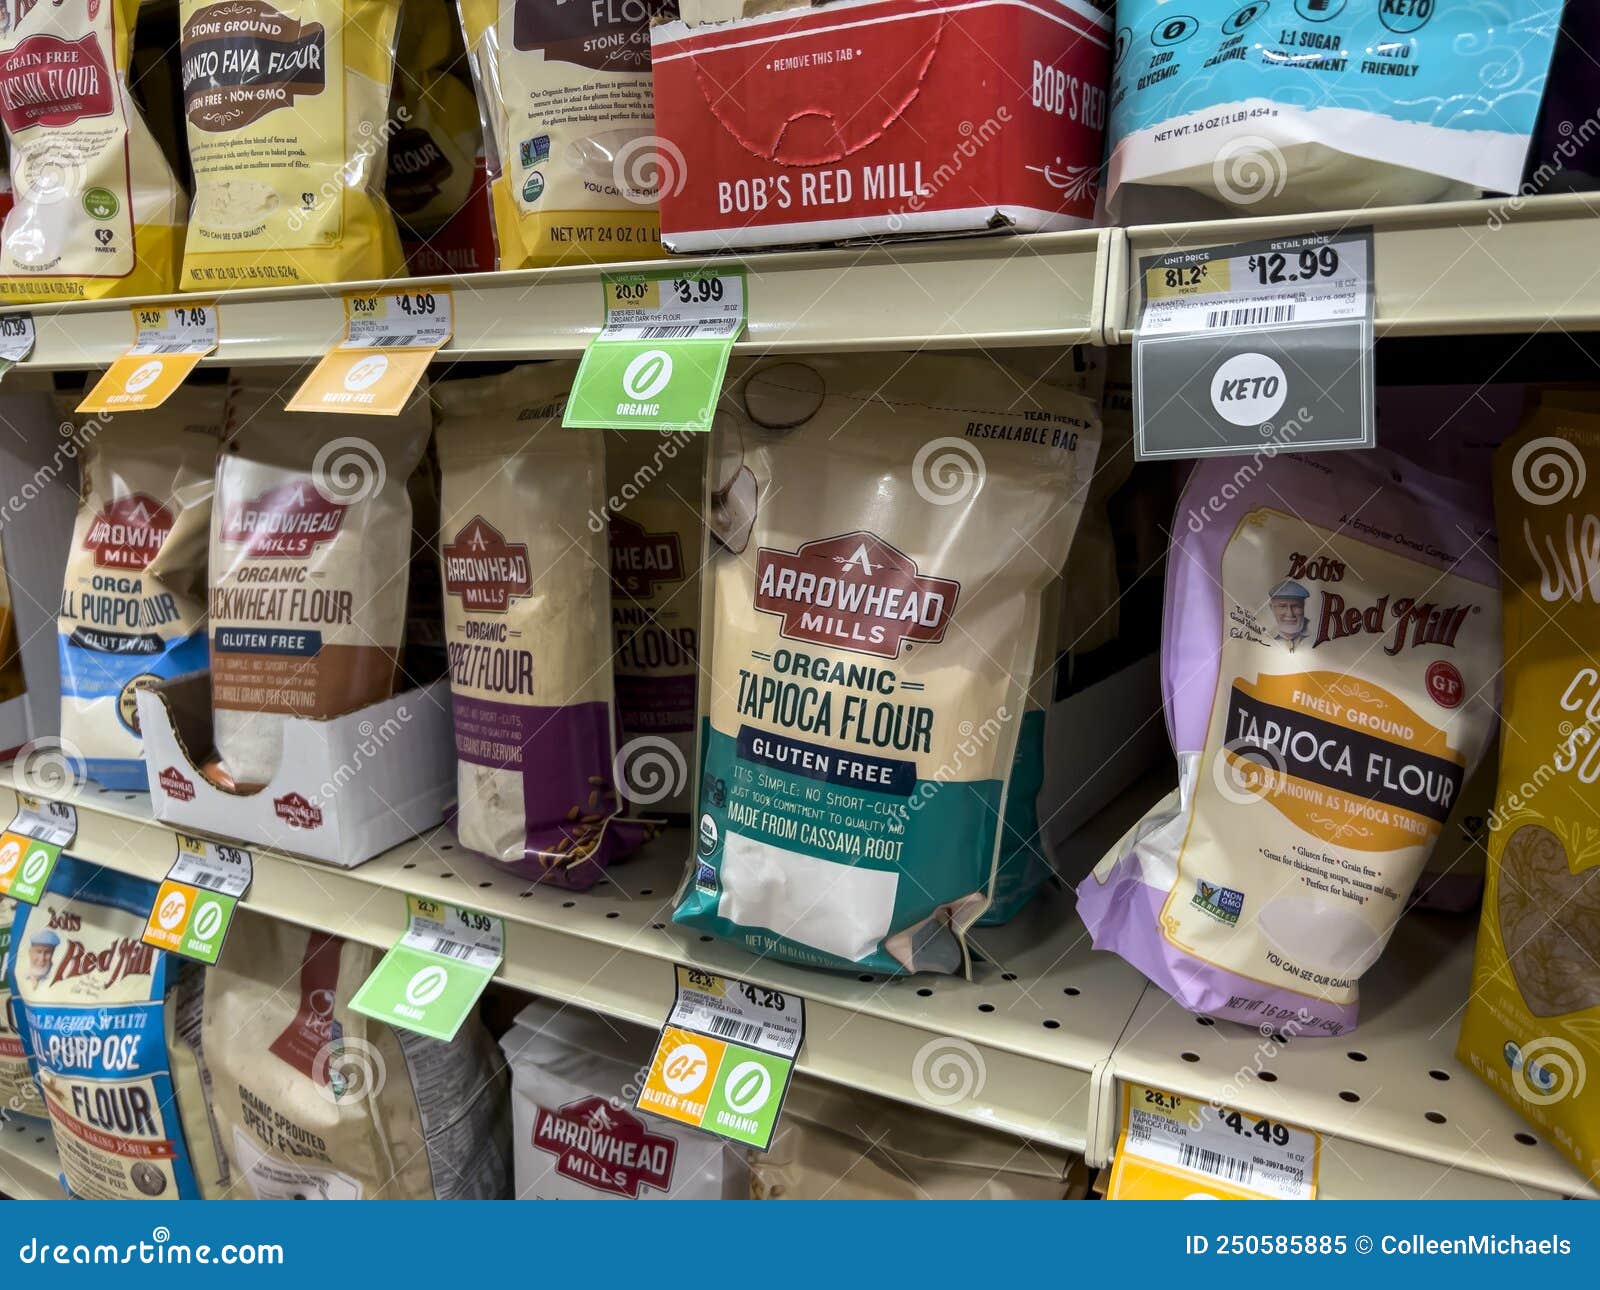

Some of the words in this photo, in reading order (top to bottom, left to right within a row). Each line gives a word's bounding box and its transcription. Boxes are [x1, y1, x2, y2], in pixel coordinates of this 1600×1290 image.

[191, 21, 221, 38] STONE
[224, 20, 282, 36] GROUND
[583, 33, 625, 52] STONE
[1219, 34, 1244, 52] ZERO
[1279, 29, 1297, 46] 1:1
[1299, 30, 1341, 51] SUGAR
[6, 52, 42, 71] GRAIN
[46, 51, 79, 64] FREE
[222, 49, 260, 75] FAVA
[268, 44, 321, 75] FLOUR
[773, 55, 810, 72] REMOVE
[812, 51, 833, 66] THIS
[835, 48, 853, 62] TAB
[1150, 51, 1174, 69] ZERO
[1203, 46, 1248, 69] CALORIE
[1361, 61, 1419, 77] FRIENDLY
[48, 65, 99, 100] FLOUR
[1033, 60, 1078, 121] BOB'S
[1137, 63, 1181, 91] GLYCEMIC
[205, 94, 222, 105] FREE
[230, 90, 254, 103] NON
[256, 88, 286, 100] GMO
[1154, 130, 1172, 143] NET
[1174, 125, 1191, 138] WT.
[1193, 123, 1204, 133] 16
[1206, 117, 1219, 130] OZ
[1221, 115, 1230, 127] (1
[1232, 110, 1248, 123] LB)
[1250, 107, 1270, 119] 454
[583, 181, 603, 193] YOU
[717, 174, 792, 215] BOB'S
[801, 168, 852, 207] RED
[863, 160, 930, 201] MILL
[550, 227, 573, 242] NET
[576, 227, 594, 242] WT
[598, 227, 612, 242] 24
[617, 227, 632, 242] OZ
[636, 226, 647, 243] (1
[1164, 255, 1184, 266] UNIT
[1185, 252, 1210, 262] PRICE
[1271, 240, 1301, 251] RETAIL
[1302, 235, 1330, 247] PRICE
[190, 268, 205, 281] NET
[217, 267, 227, 280] 22
[1248, 246, 1339, 285] $12.99
[673, 277, 724, 303] $3.99
[396, 293, 436, 316] $4.99
[1220, 375, 1279, 402] KETO
[616, 403, 660, 416] ORGANIC
[1023, 410, 1051, 423] TEAR
[965, 422, 1048, 446] RESEALABLE
[1051, 429, 1079, 452] BAG
[229, 508, 343, 535] ARROWHEAD
[256, 539, 307, 552] MILLS
[236, 566, 307, 583] ORGANIC
[447, 555, 527, 585] ARROWHEAD
[1287, 551, 1346, 582] Bob's
[289, 588, 353, 625] FLOUR
[466, 588, 504, 604] MILLS
[760, 562, 945, 629] ARROWHEAD
[466, 620, 507, 642] ORGANIC
[800, 612, 886, 645] MILLS
[1312, 590, 1389, 649] Red
[1383, 596, 1472, 656] Mill
[221, 633, 267, 649] GLUTEN
[271, 636, 306, 650] FREE
[617, 628, 697, 669] FLOUR
[476, 649, 534, 696] FLOUR
[773, 648, 897, 694] ORGANIC
[1433, 676, 1457, 695] GF
[737, 668, 833, 737] TAPIOCA
[839, 695, 935, 754] FLOUR
[1292, 690, 1341, 717] FINELY
[1346, 708, 1414, 742] GROUND
[492, 742, 523, 763] SERVING
[751, 737, 830, 773] GLUTEN
[836, 759, 894, 785] FREE
[1238, 706, 1353, 778] TAPIOCA
[1365, 752, 1455, 810] FLOUR
[733, 765, 753, 783] IT'S
[758, 773, 801, 797] SIMPLE:
[805, 788, 821, 802] NO
[730, 786, 750, 798] JUST
[752, 791, 770, 806] 100%
[773, 798, 826, 820] COMMITMENT
[829, 812, 842, 825] TO
[845, 816, 886, 832] QUALITY
[1279, 782, 1323, 806] KNOWN
[1325, 796, 1340, 811] AS
[1344, 799, 1389, 825] TAPIOCA
[1392, 814, 1428, 836] STARCH
[727, 800, 761, 830] MADE
[761, 812, 798, 841] FROM
[800, 823, 861, 856] CASSAVA
[865, 837, 904, 862] ROOT
[1263, 849, 1281, 863] Great
[1283, 855, 1292, 866] for
[1293, 859, 1328, 880] thickening
[1330, 872, 1351, 885] soups,
[1352, 878, 1372, 891] sauces
[1297, 846, 1321, 861] Gluten
[1322, 854, 1335, 865] free
[1341, 860, 1361, 873] Grain
[1363, 866, 1376, 877] free
[1221, 897, 1241, 909] GMO
[1223, 890, 1243, 902] NON
[1306, 877, 1329, 893] Perfect
[1330, 885, 1341, 896] for
[1342, 889, 1364, 905] baking
[162, 901, 186, 918] GF
[187, 938, 212, 954] ORGANIC
[745, 934, 762, 946] NET
[50, 938, 119, 988] Red
[1266, 951, 1283, 967] YOU
[1282, 961, 1300, 977] CAN
[1300, 970, 1312, 982] SEE
[1314, 974, 1329, 987] OUR
[1225, 996, 1248, 1009] NET
[1261, 1004, 1278, 1017] 16
[666, 1055, 706, 1081] GF
[71, 1085, 159, 1137] FLOUR
[238, 1084, 273, 1122] ORGANIC
[274, 1111, 326, 1152] SPROUTED
[643, 1087, 704, 1116] GLUTEN-FREE
[717, 1110, 758, 1134] ORGANIC
[241, 1103, 274, 1147] SPELT
[1134, 1115, 1162, 1129] TAPIOCA
[1163, 1123, 1187, 1137] FLOUR
[1218, 1107, 1290, 1147] $4.49
[539, 1114, 668, 1175] ARROWHEAD
[1295, 1154, 1305, 1162] OZ
[567, 1154, 628, 1186] MILLS
